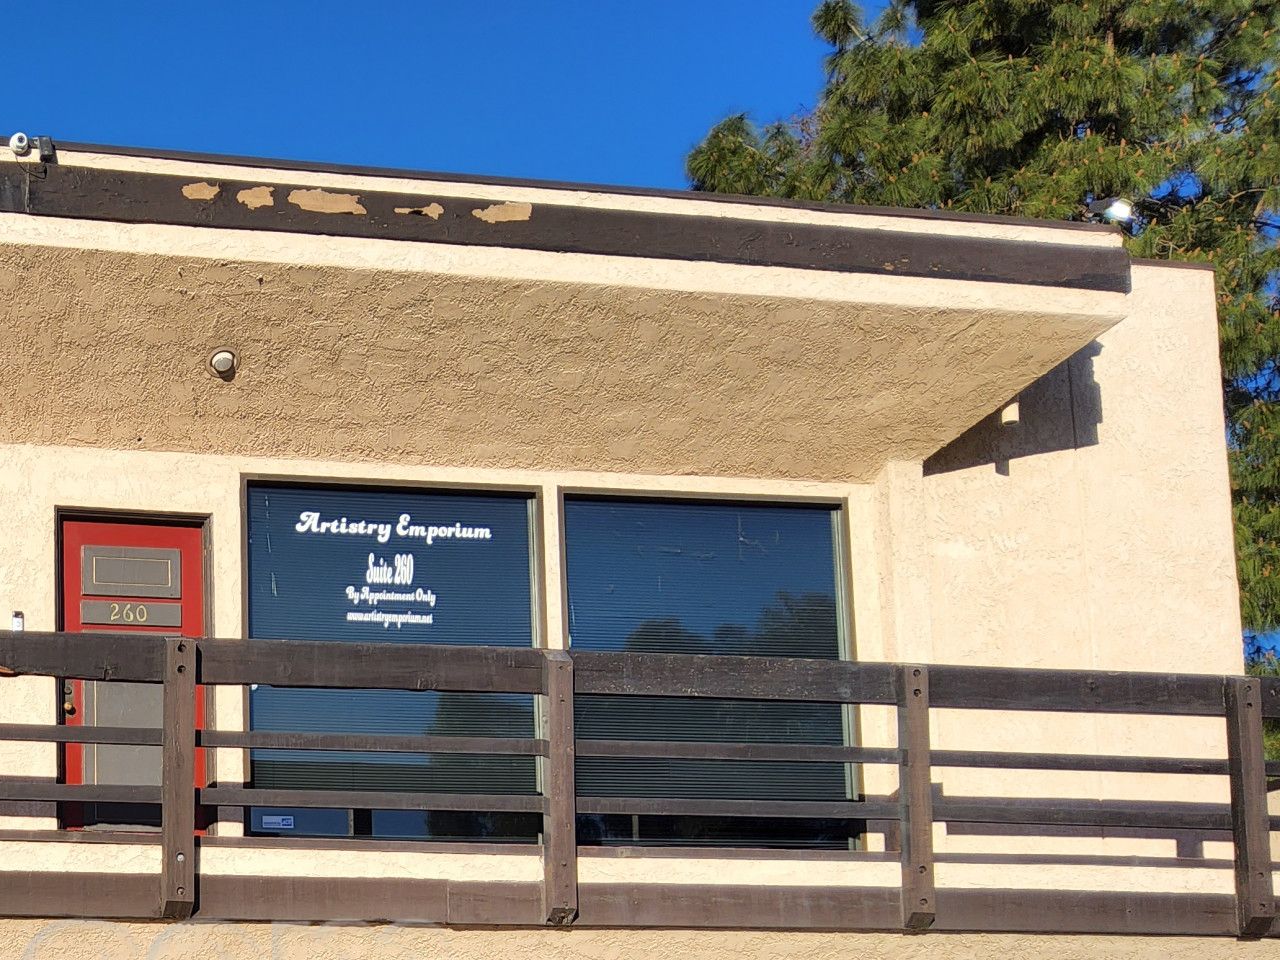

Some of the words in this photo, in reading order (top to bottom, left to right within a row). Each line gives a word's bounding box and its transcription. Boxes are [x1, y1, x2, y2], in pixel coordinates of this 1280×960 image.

[295, 511, 391, 543] Artistry
[396, 513, 492, 544] Emporium
[366, 552, 393, 584] Suite
[394, 553, 414, 585] 260
[345, 586, 360, 604] By
[360, 586, 415, 605] Appointment
[416, 588, 436, 606] Only
[110, 603, 147, 622] 260
